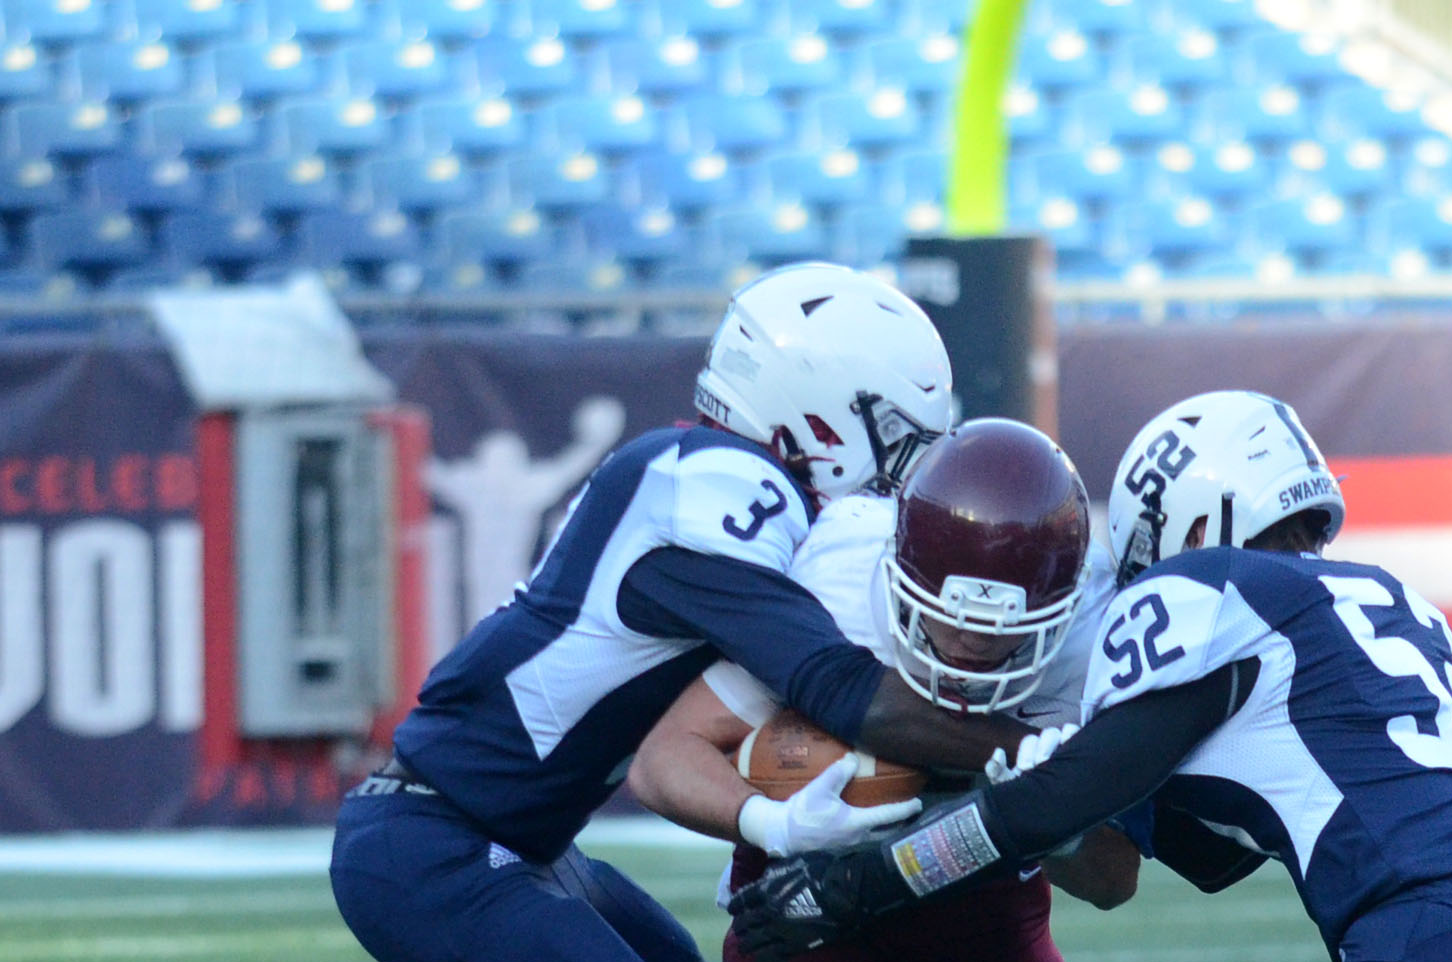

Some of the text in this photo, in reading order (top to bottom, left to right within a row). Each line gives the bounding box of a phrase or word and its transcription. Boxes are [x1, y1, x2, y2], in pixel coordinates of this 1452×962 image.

[1124, 430, 1197, 503] 52
[722, 479, 788, 541] 3
[1102, 593, 1187, 690] 52
